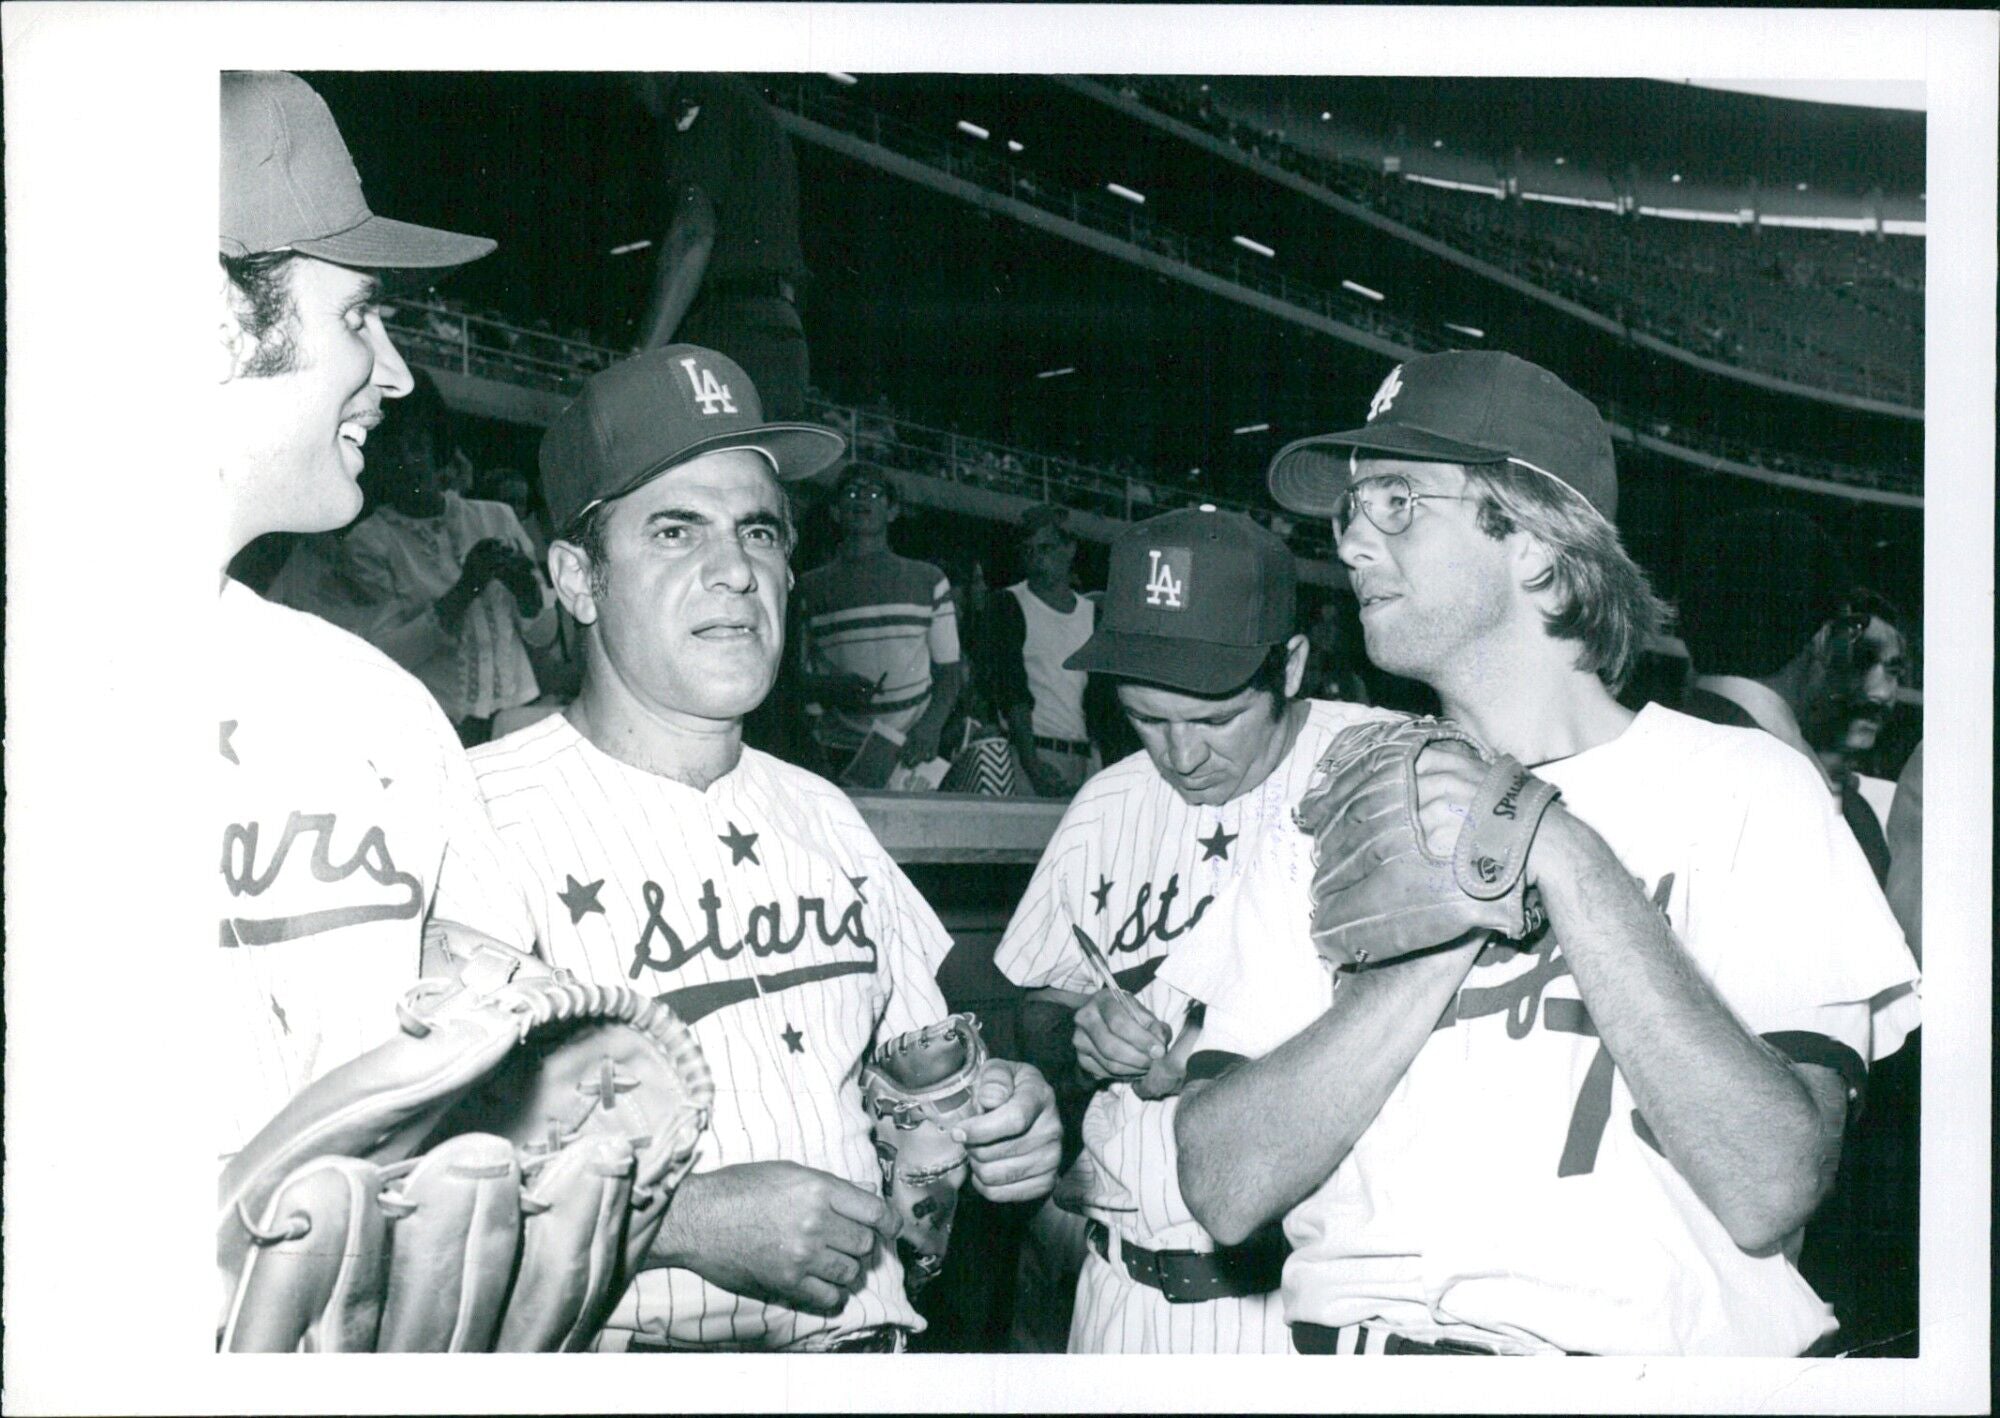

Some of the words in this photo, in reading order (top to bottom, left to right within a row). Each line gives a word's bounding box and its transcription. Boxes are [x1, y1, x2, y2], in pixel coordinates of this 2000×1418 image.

[681, 358, 738, 415] LA
[1146, 550, 1181, 607] LA
[219, 809, 423, 900] ars
[628, 880, 878, 980] Stars
